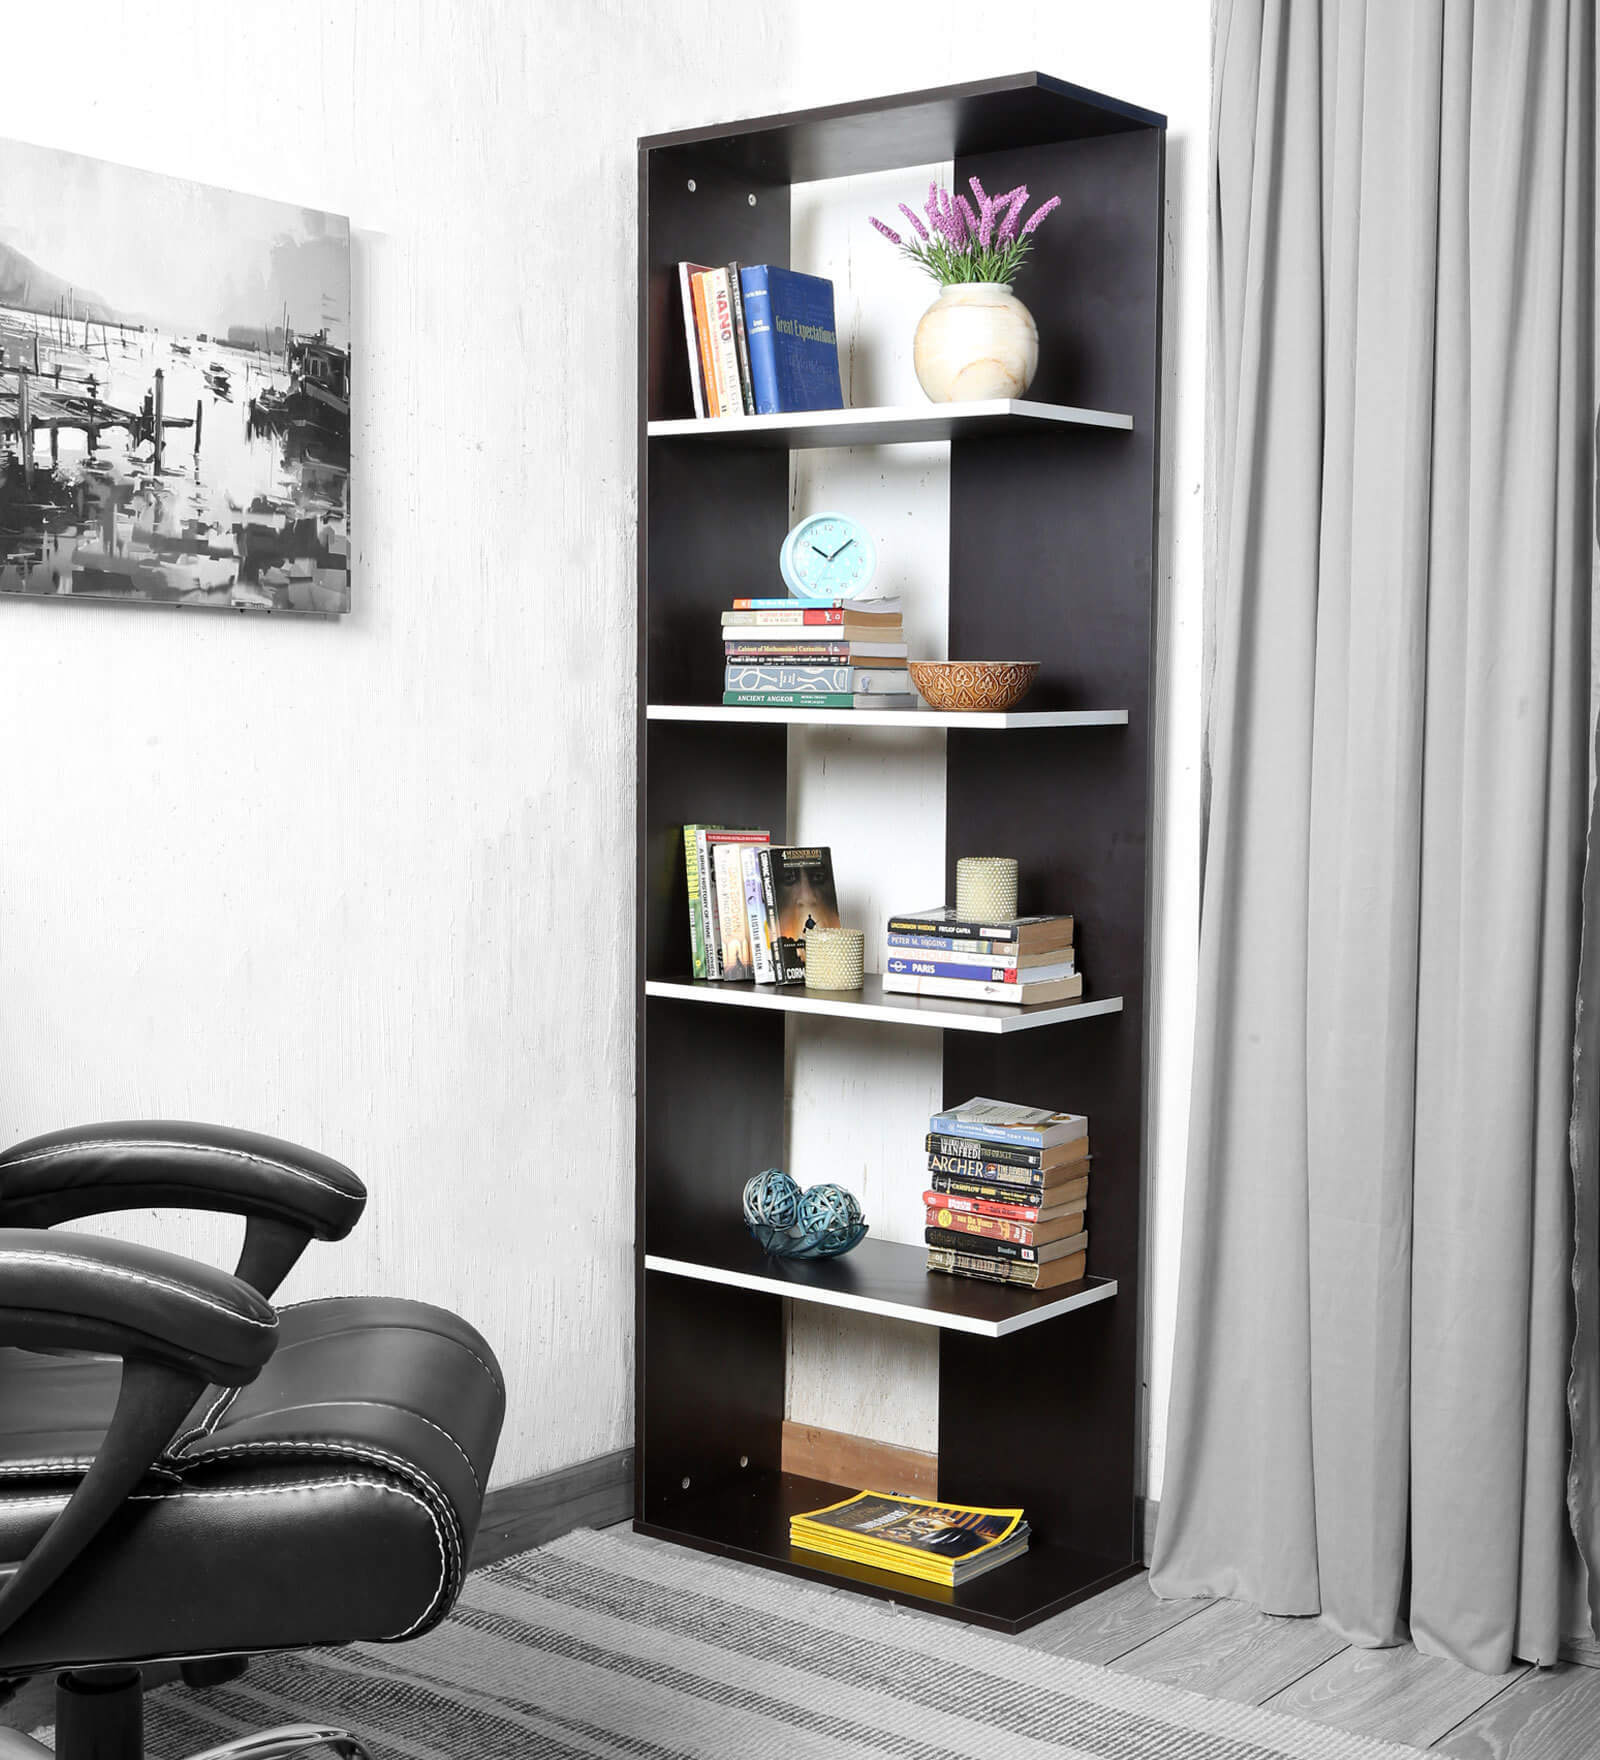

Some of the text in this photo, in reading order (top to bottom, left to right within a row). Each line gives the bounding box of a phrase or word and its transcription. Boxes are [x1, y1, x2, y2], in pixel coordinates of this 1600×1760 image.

[716, 289, 732, 342] NANO
[775, 315, 836, 345] Great Expectations
[767, 695, 794, 703] ANGKOR
[703, 910, 709, 920] OF
[891, 936, 910, 945] PETER
[920, 939, 946, 947] HIGGINS
[786, 967, 807, 980] CORM
[912, 963, 935, 973] PARIS
[940, 1143, 982, 1160] MANFREDI
[930, 1155, 984, 1178] ARCHER
